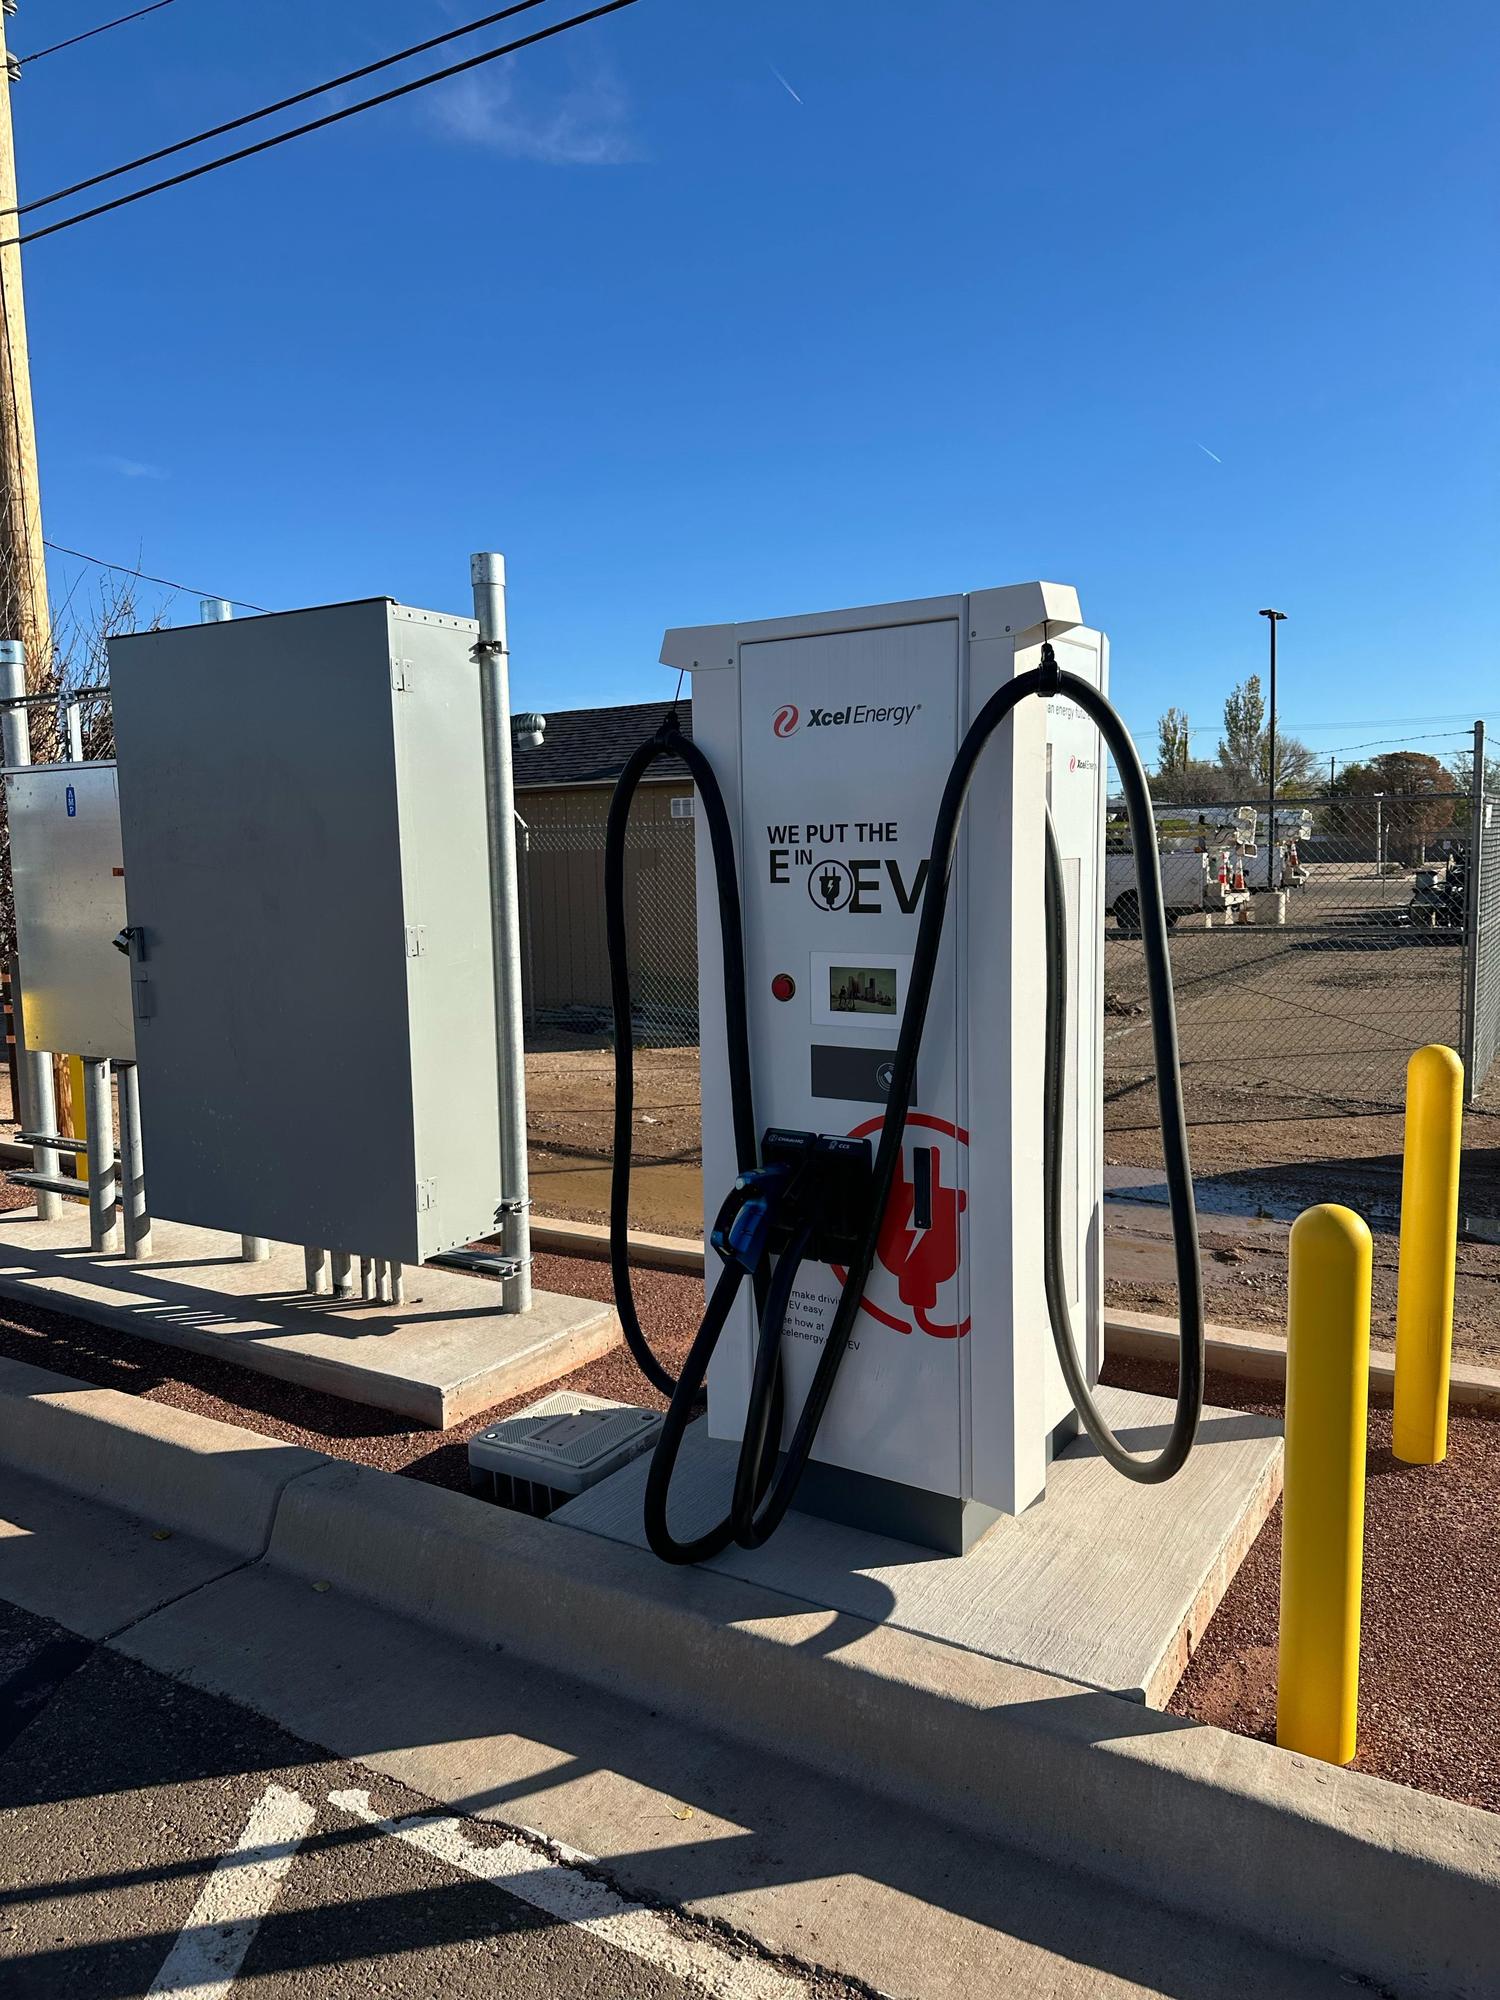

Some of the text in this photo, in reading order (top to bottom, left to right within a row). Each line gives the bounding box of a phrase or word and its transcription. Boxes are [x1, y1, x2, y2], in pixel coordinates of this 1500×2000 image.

[806, 706, 852, 727] Xcel
[767, 822, 898, 844] WE PUT THE
[769, 849, 932, 914] E IN EV
[792, 1290, 840, 1305] make drivi
[789, 1300, 824, 1316] EV easy
[794, 1316, 814, 1328] how
[816, 1322, 825, 1331] at
